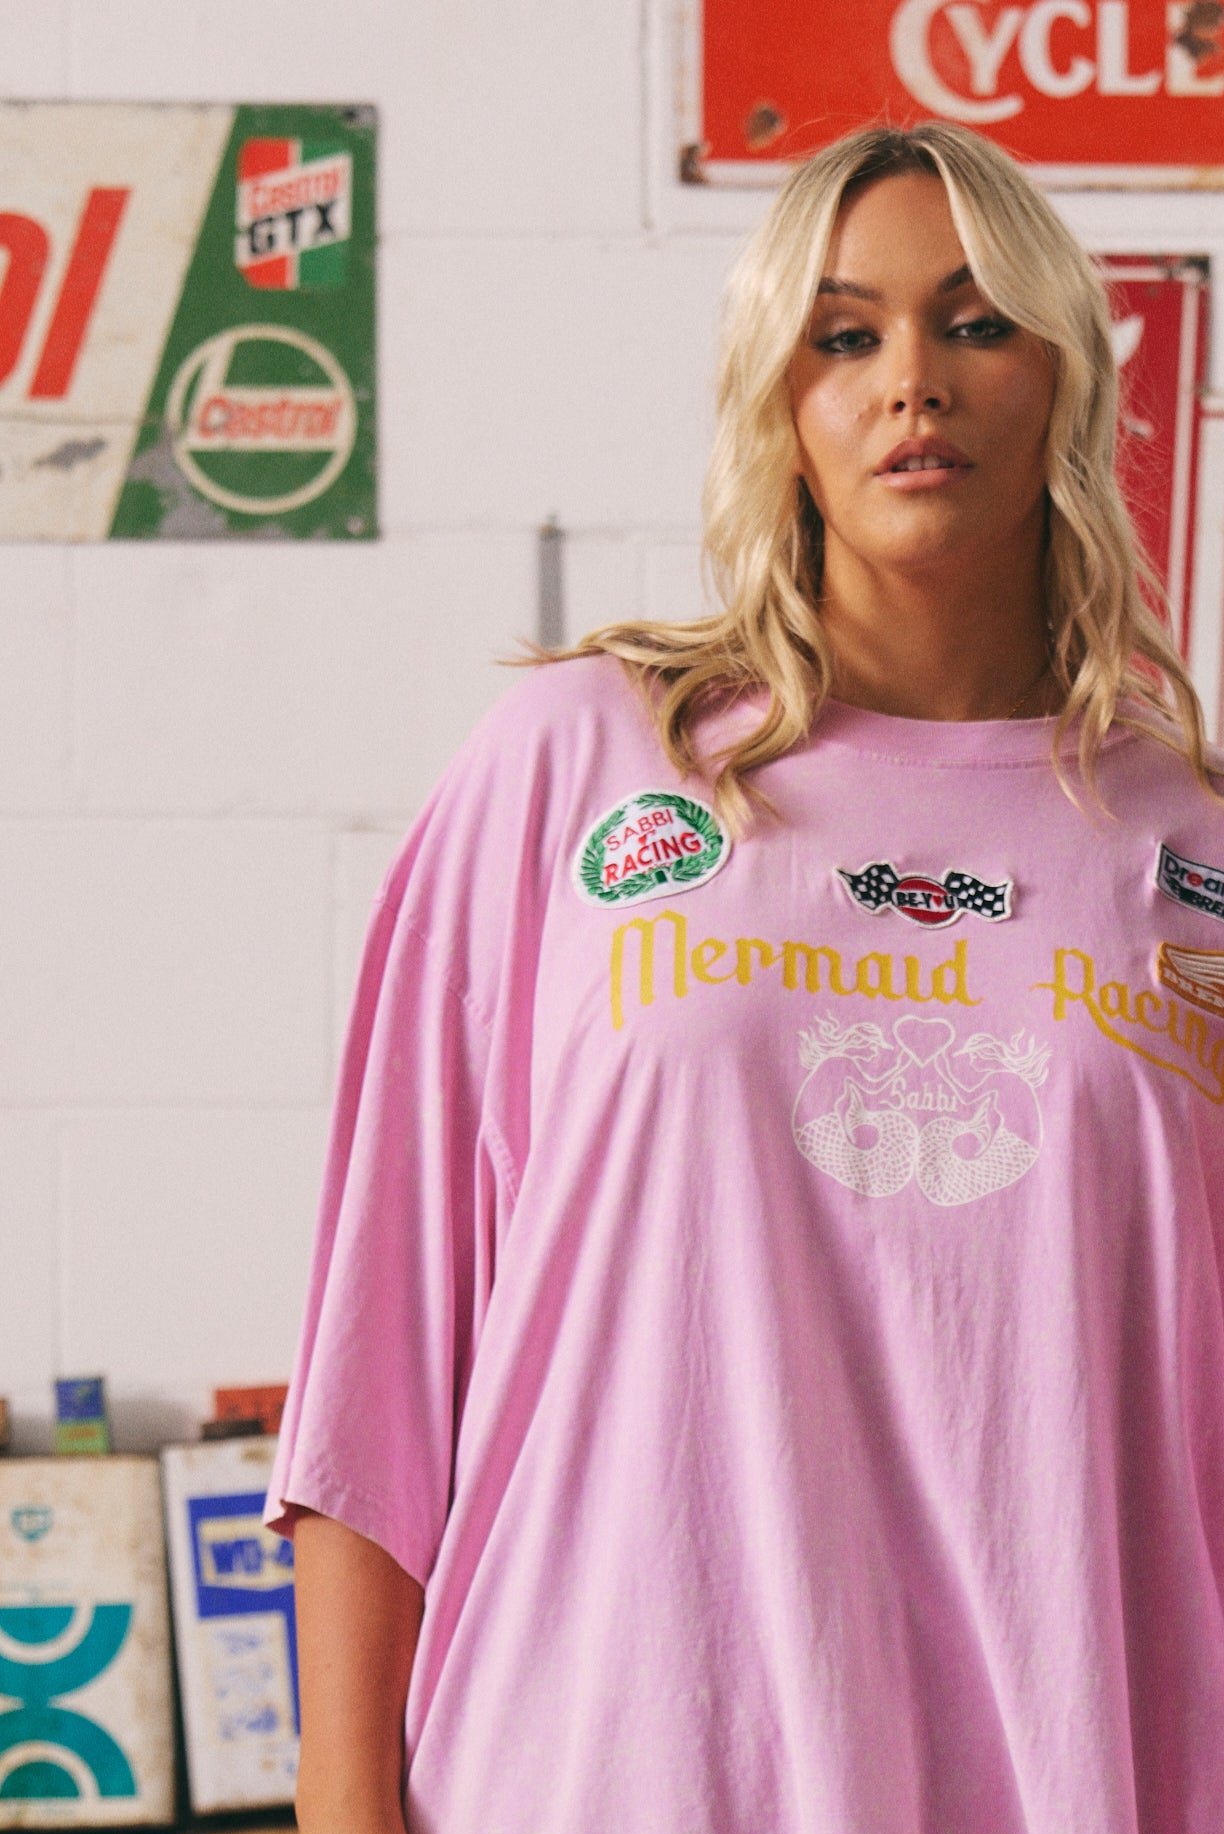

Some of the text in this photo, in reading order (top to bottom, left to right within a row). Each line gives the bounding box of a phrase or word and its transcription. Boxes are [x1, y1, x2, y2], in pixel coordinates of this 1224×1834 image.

[248, 199, 336, 255] GTX
[198, 395, 344, 438] Castrol
[606, 808, 673, 851] SABBI
[603, 832, 700, 886] RACING
[610, 909, 983, 1031] Mermaid
[879, 1076, 958, 1113] Sabbi
